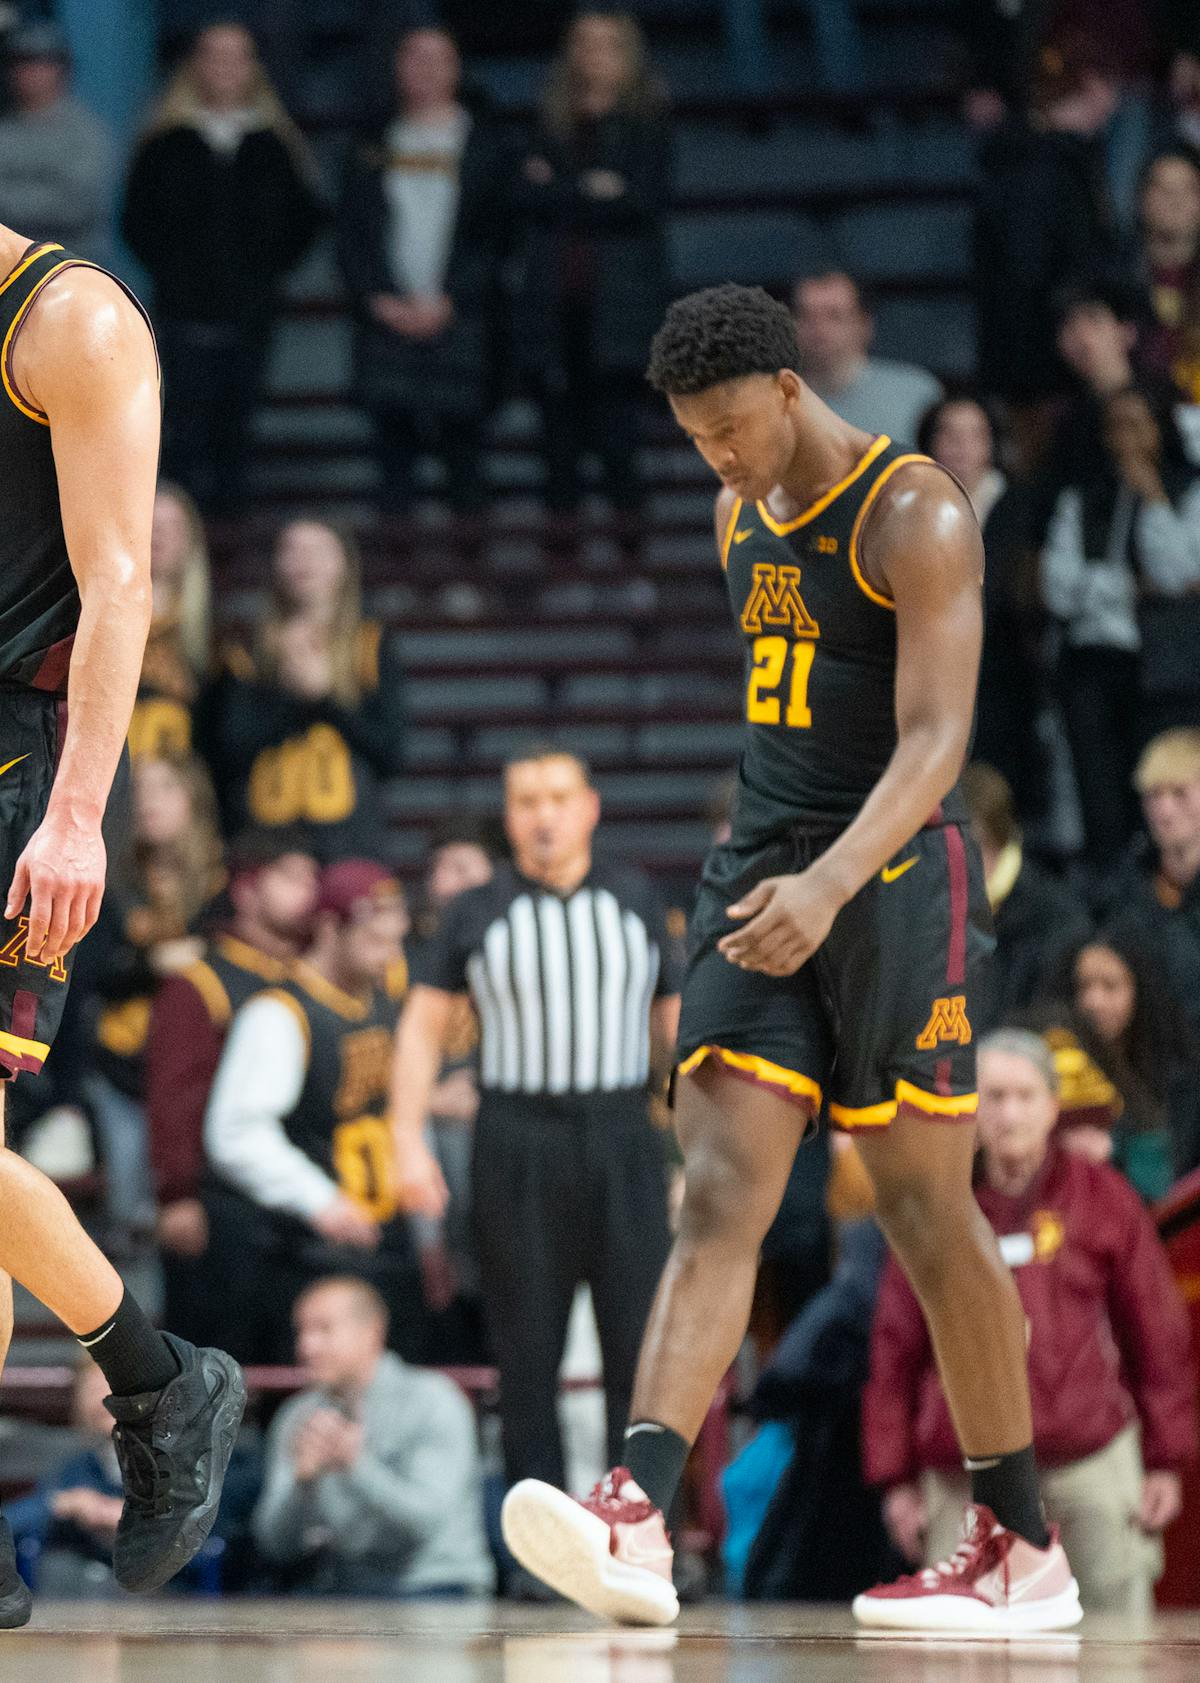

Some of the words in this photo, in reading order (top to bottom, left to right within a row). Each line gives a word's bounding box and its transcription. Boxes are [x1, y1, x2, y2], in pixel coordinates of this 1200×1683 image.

[741, 563, 821, 639] M
[748, 636, 816, 729] 21
[916, 995, 972, 1051] M
